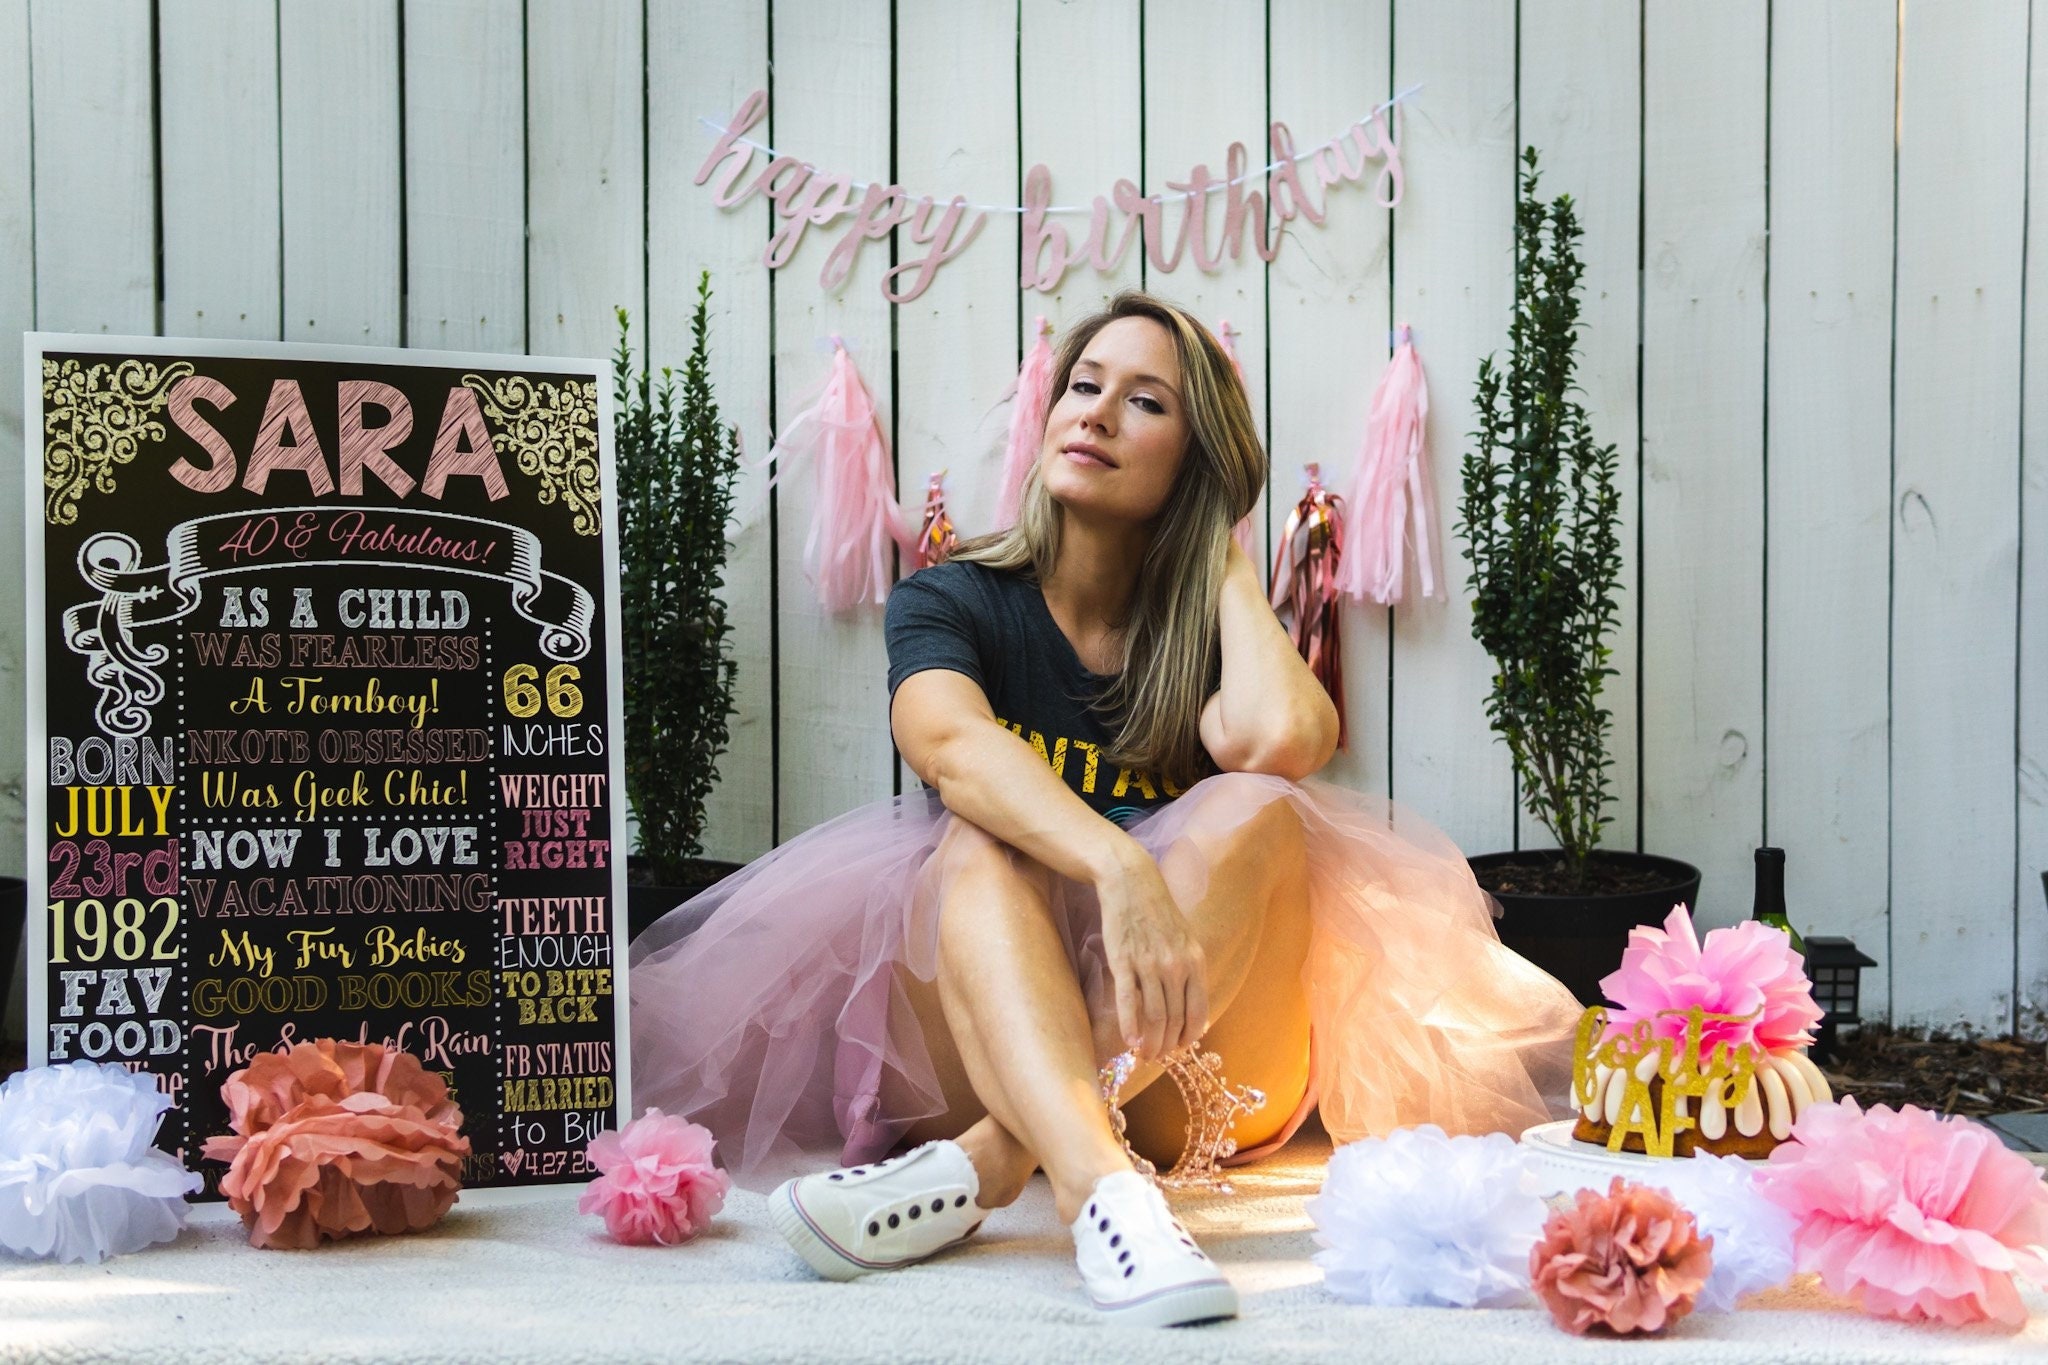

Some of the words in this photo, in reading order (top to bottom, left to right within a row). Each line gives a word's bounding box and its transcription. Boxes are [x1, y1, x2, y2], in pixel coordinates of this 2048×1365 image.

[693, 89, 986, 303] happy
[1021, 99, 1405, 293] birthday
[167, 375, 510, 502] SARA
[219, 516, 279, 561] 40
[284, 512, 320, 558] &
[328, 511, 496, 564] Fabulous!
[219, 587, 269, 628] AS
[289, 587, 318, 628] A
[338, 588, 470, 629] CHILD
[191, 633, 282, 669] WAS
[289, 635, 480, 671] FEARLESS
[229, 677, 272, 714] A
[280, 677, 439, 729] Tomboy!
[503, 664, 583, 718] 66
[51, 736, 175, 786] BORN
[187, 729, 311, 764] NKOTB
[318, 728, 490, 764] OBSESSED
[503, 723, 604, 756] INCHES
[55, 786, 177, 837] JULY
[202, 771, 283, 808] Was
[293, 770, 374, 822] Geek
[384, 769, 468, 806] Chic!
[499, 774, 606, 808] WEIGHT
[522, 809, 590, 838] JUST
[49, 839, 179, 898] 23rd
[192, 828, 302, 870] NOW
[324, 828, 341, 867] I
[364, 827, 479, 866] LOVE
[504, 840, 609, 869] RIGHT
[186, 873, 493, 917] VACATIONING
[498, 896, 606, 935] TEETH
[47, 897, 180, 963] 1982
[209, 928, 276, 978] My
[287, 926, 357, 970] Fur
[365, 925, 467, 968] Babies
[501, 935, 611, 968] ENOUGH
[60, 967, 173, 1017] FAV
[192, 976, 328, 1017] GOOD
[338, 970, 492, 1011] BOOKS
[502, 971, 541, 998] TO
[546, 969, 612, 997] BITE
[518, 996, 598, 1025] BACK
[50, 1019, 182, 1059] FOOD
[191, 1020, 259, 1077] The
[420, 1016, 494, 1069] Rain
[505, 1045, 531, 1077] FB
[537, 1041, 611, 1075] STATUS
[1573, 1004, 1765, 1108] forty
[503, 1076, 614, 1112] MARRIED
[511, 1115, 546, 1146] to
[564, 1111, 605, 1144] Bill
[1606, 1076, 1703, 1157] AF
